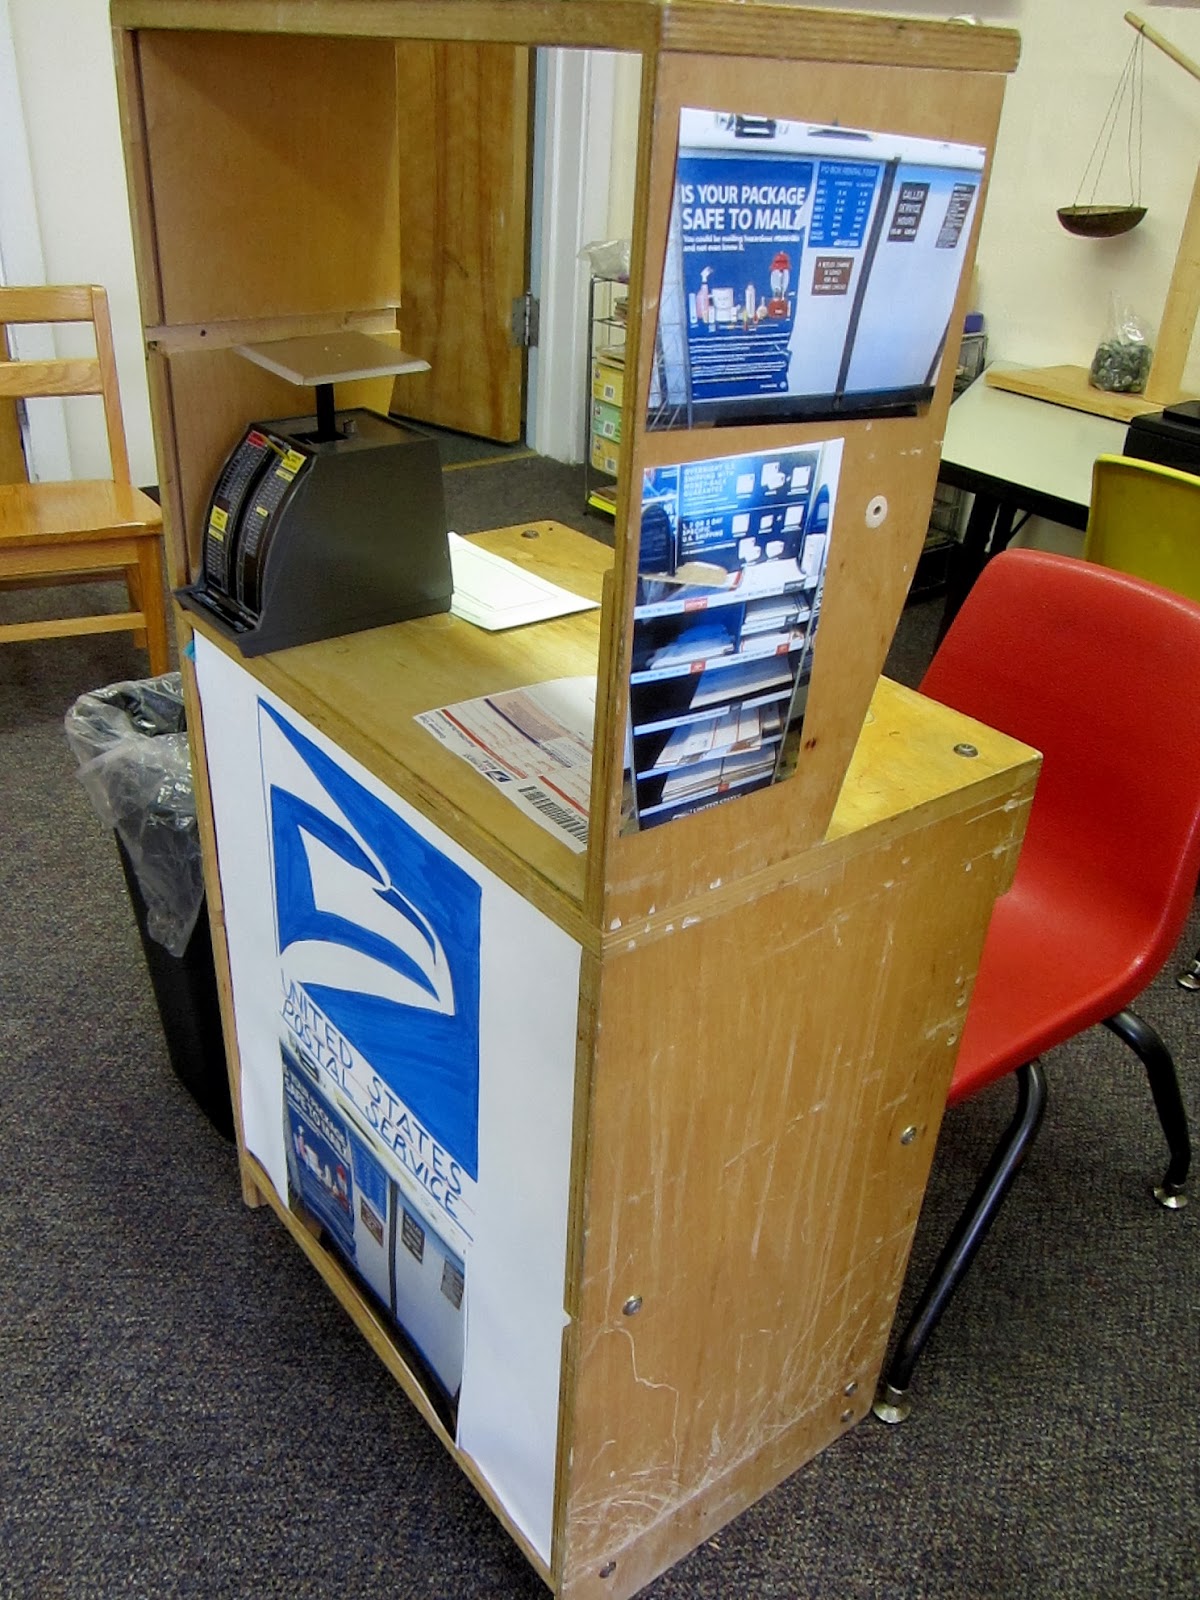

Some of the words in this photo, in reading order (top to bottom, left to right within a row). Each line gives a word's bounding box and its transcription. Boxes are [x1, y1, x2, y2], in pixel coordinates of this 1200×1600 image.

[681, 184, 695, 204] IS
[697, 184, 738, 204] YOUR
[741, 186, 806, 206] PACKAGE
[682, 208, 726, 230] SAFE
[729, 208, 752, 230] TO
[281, 967, 353, 1070] UNITED
[367, 1076, 462, 1195] STATES
[281, 999, 354, 1102] POSTAL
[365, 1101, 458, 1219] SERVICE
